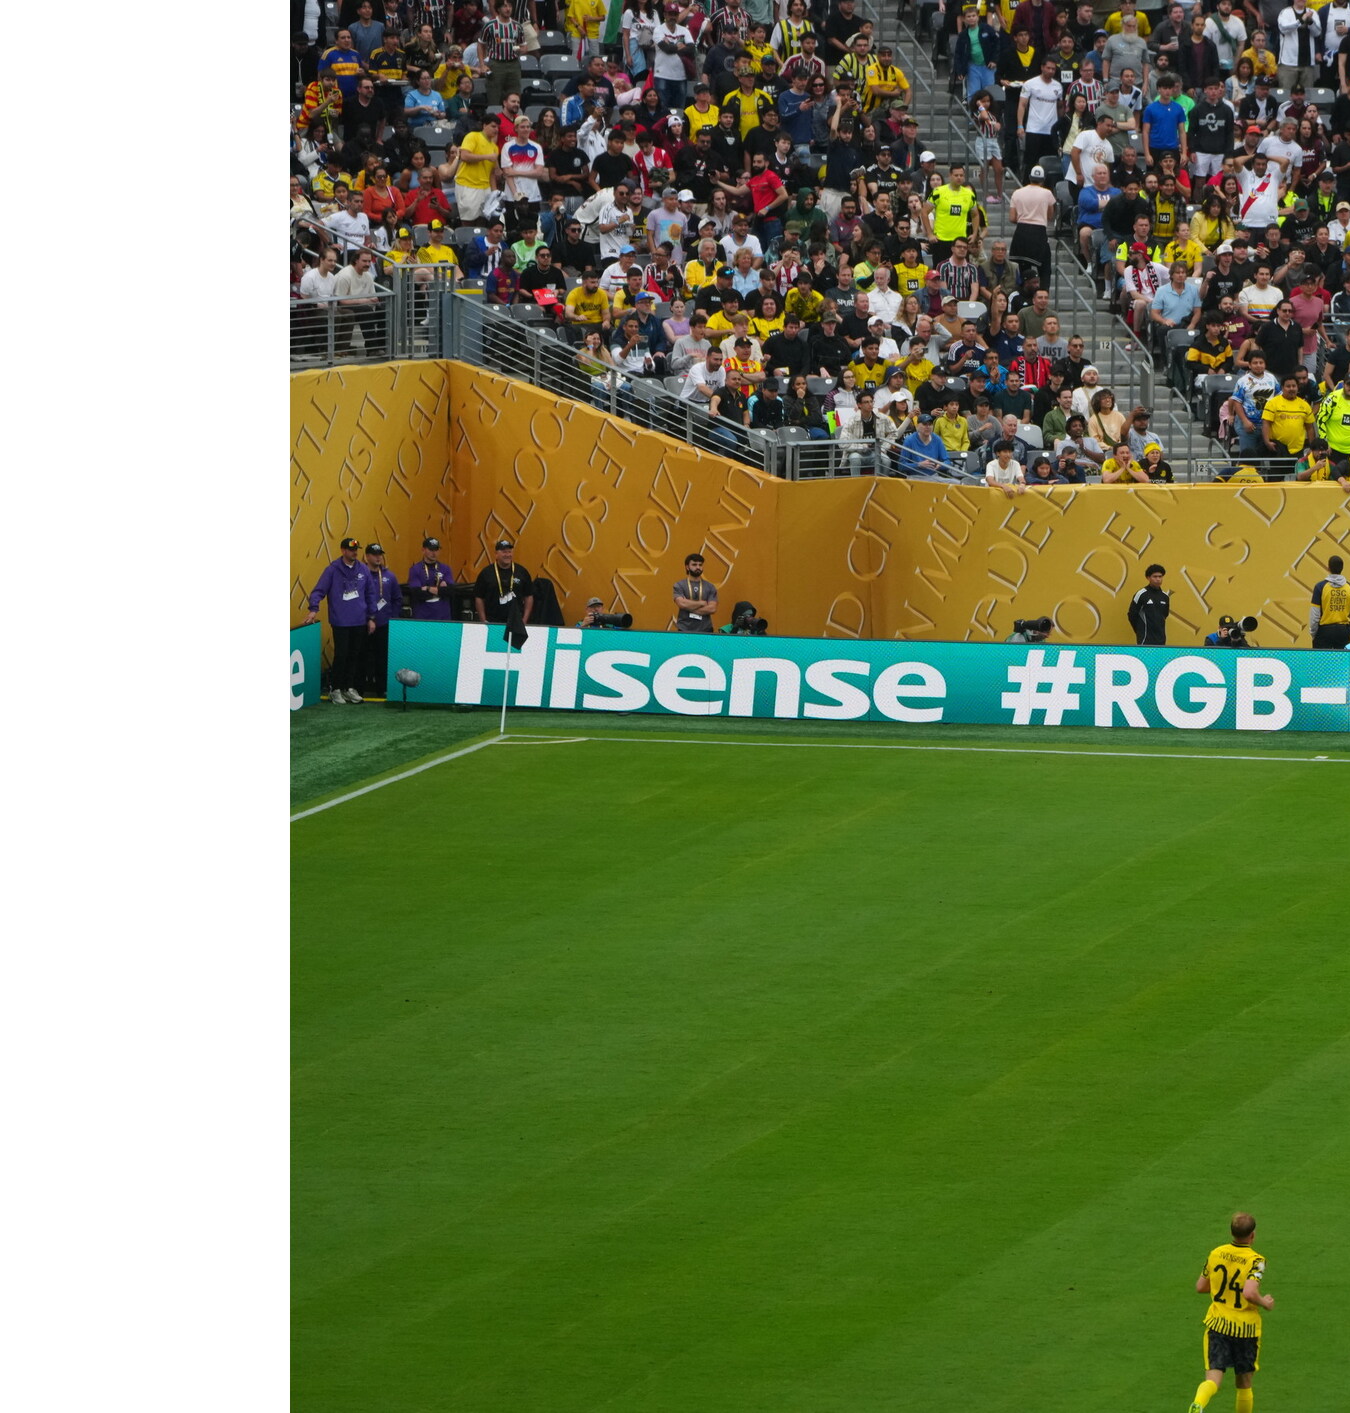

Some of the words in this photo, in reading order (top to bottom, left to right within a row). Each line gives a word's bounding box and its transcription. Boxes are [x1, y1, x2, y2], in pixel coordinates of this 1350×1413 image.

[1041, 347, 1063, 356] JUST
[1331, 589, 1347, 597] CSC
[1330, 597, 1346, 605] EVENT
[454, 623, 947, 722] Hisense
[1213, 1264, 1244, 1309] 24
